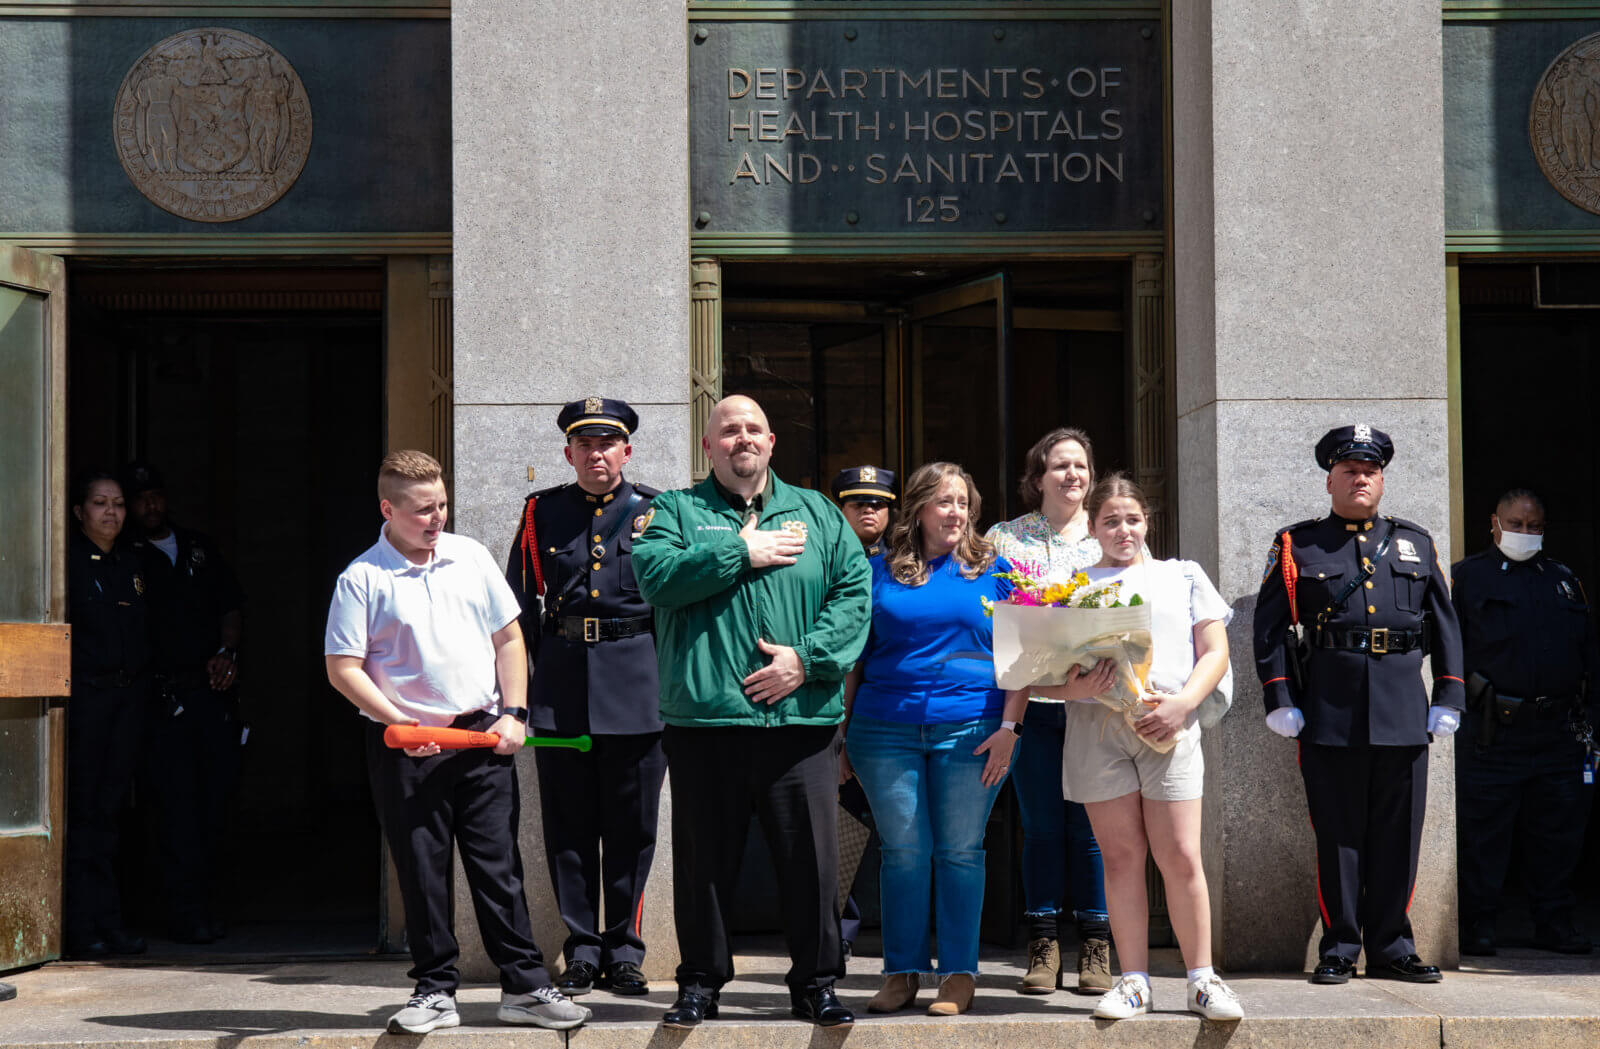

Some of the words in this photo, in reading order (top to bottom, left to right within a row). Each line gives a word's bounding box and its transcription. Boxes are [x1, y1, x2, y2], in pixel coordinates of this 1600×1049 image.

[727, 67, 1045, 99] DEPARTMENTS
[1066, 66, 1122, 99] OF
[728, 108, 880, 142] HEALTH
[904, 108, 1125, 142] HOSPITALS
[730, 152, 822, 185] AND
[865, 152, 1125, 184] SANITATION
[906, 196, 961, 223] 125
